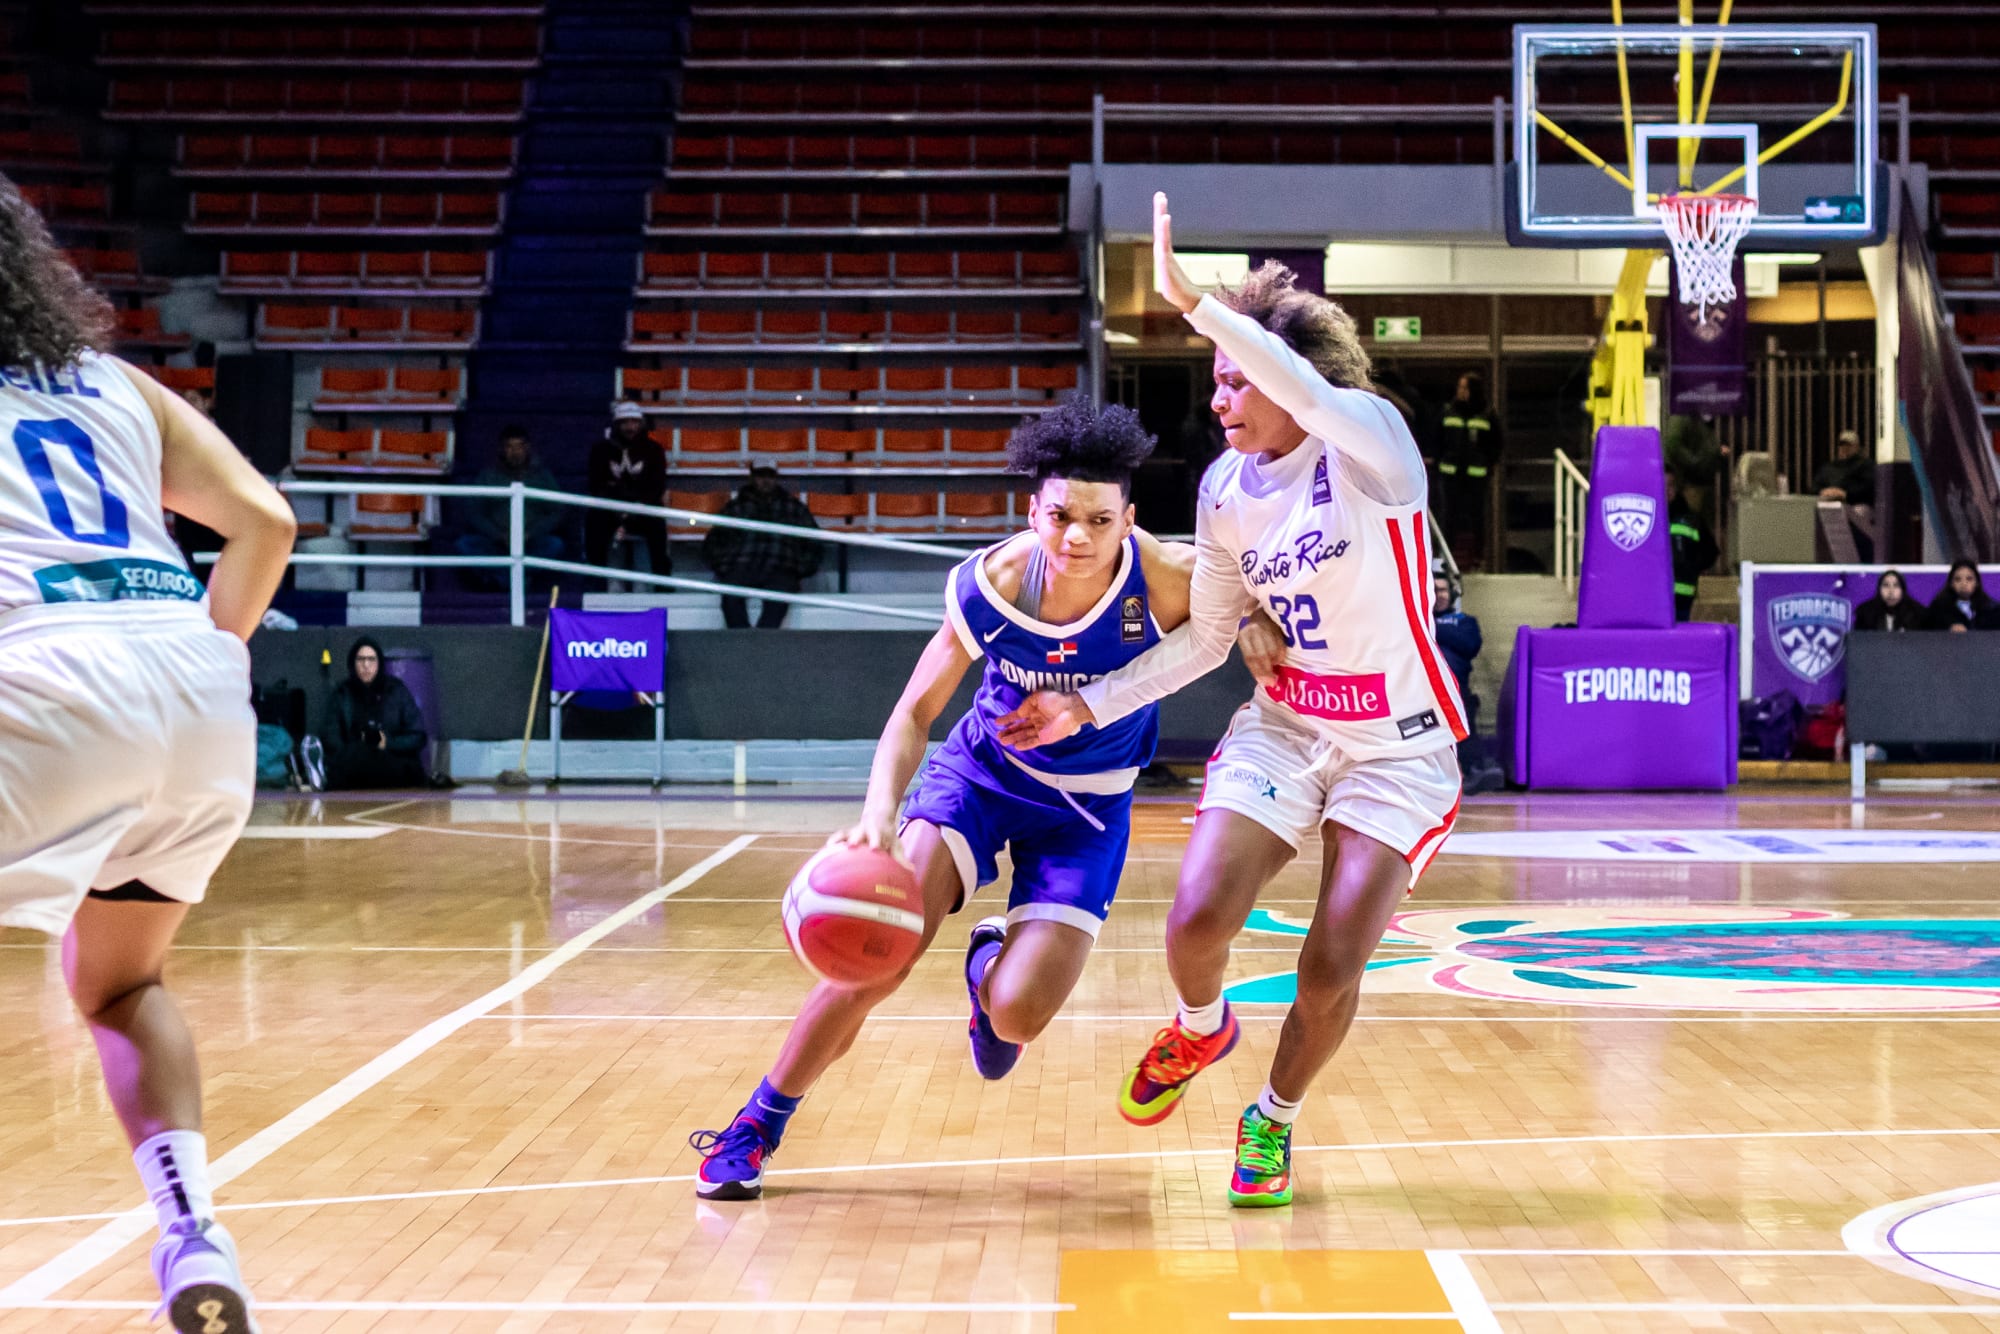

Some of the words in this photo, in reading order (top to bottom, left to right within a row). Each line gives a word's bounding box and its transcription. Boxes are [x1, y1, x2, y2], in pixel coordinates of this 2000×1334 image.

[12, 418, 130, 549] 0
[1241, 549, 1291, 588] Puerto
[1294, 530, 1351, 573] Rico
[121, 567, 197, 597] SEGUROS
[1124, 623, 1142, 632] FIBA
[1269, 594, 1328, 650] 32
[1774, 599, 1846, 621] TEPORACAS
[566, 637, 648, 658] molten
[1284, 677, 1379, 713] Mobile
[1562, 667, 1691, 706] TEPORACAS
